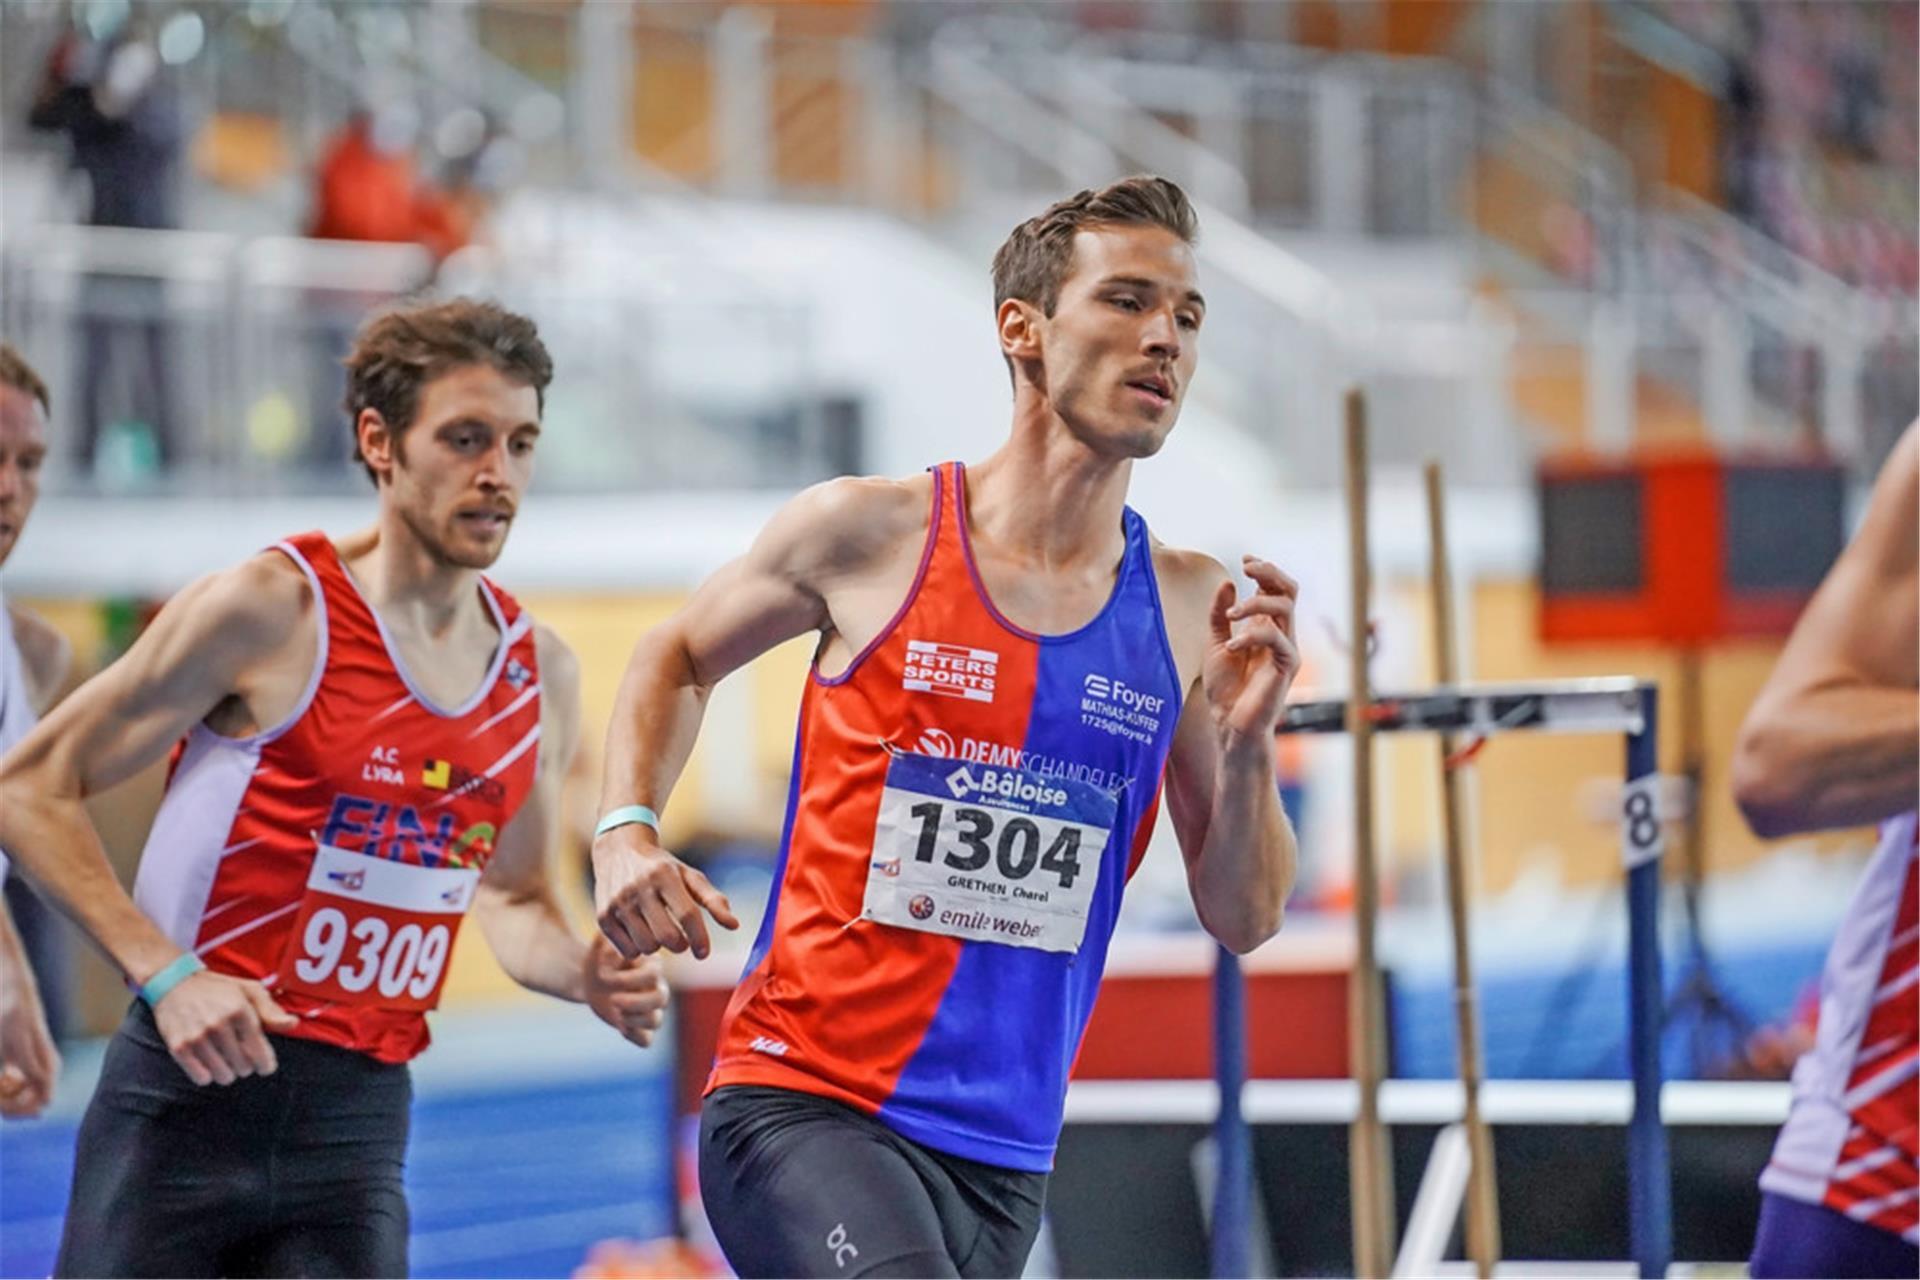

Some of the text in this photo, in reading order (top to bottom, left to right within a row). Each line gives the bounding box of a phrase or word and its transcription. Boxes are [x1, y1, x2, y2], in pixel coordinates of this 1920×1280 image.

[903, 665, 995, 690] SPORTS
[904, 651, 998, 676] PETERS
[1112, 681, 1165, 714] Foyer
[361, 764, 404, 785] LYRA
[981, 769, 1068, 807] Bâloise
[1624, 790, 1659, 849] 8
[911, 801, 1083, 889] 1304
[947, 875, 1049, 902] GRETHEN Charel
[295, 907, 450, 999] 9309
